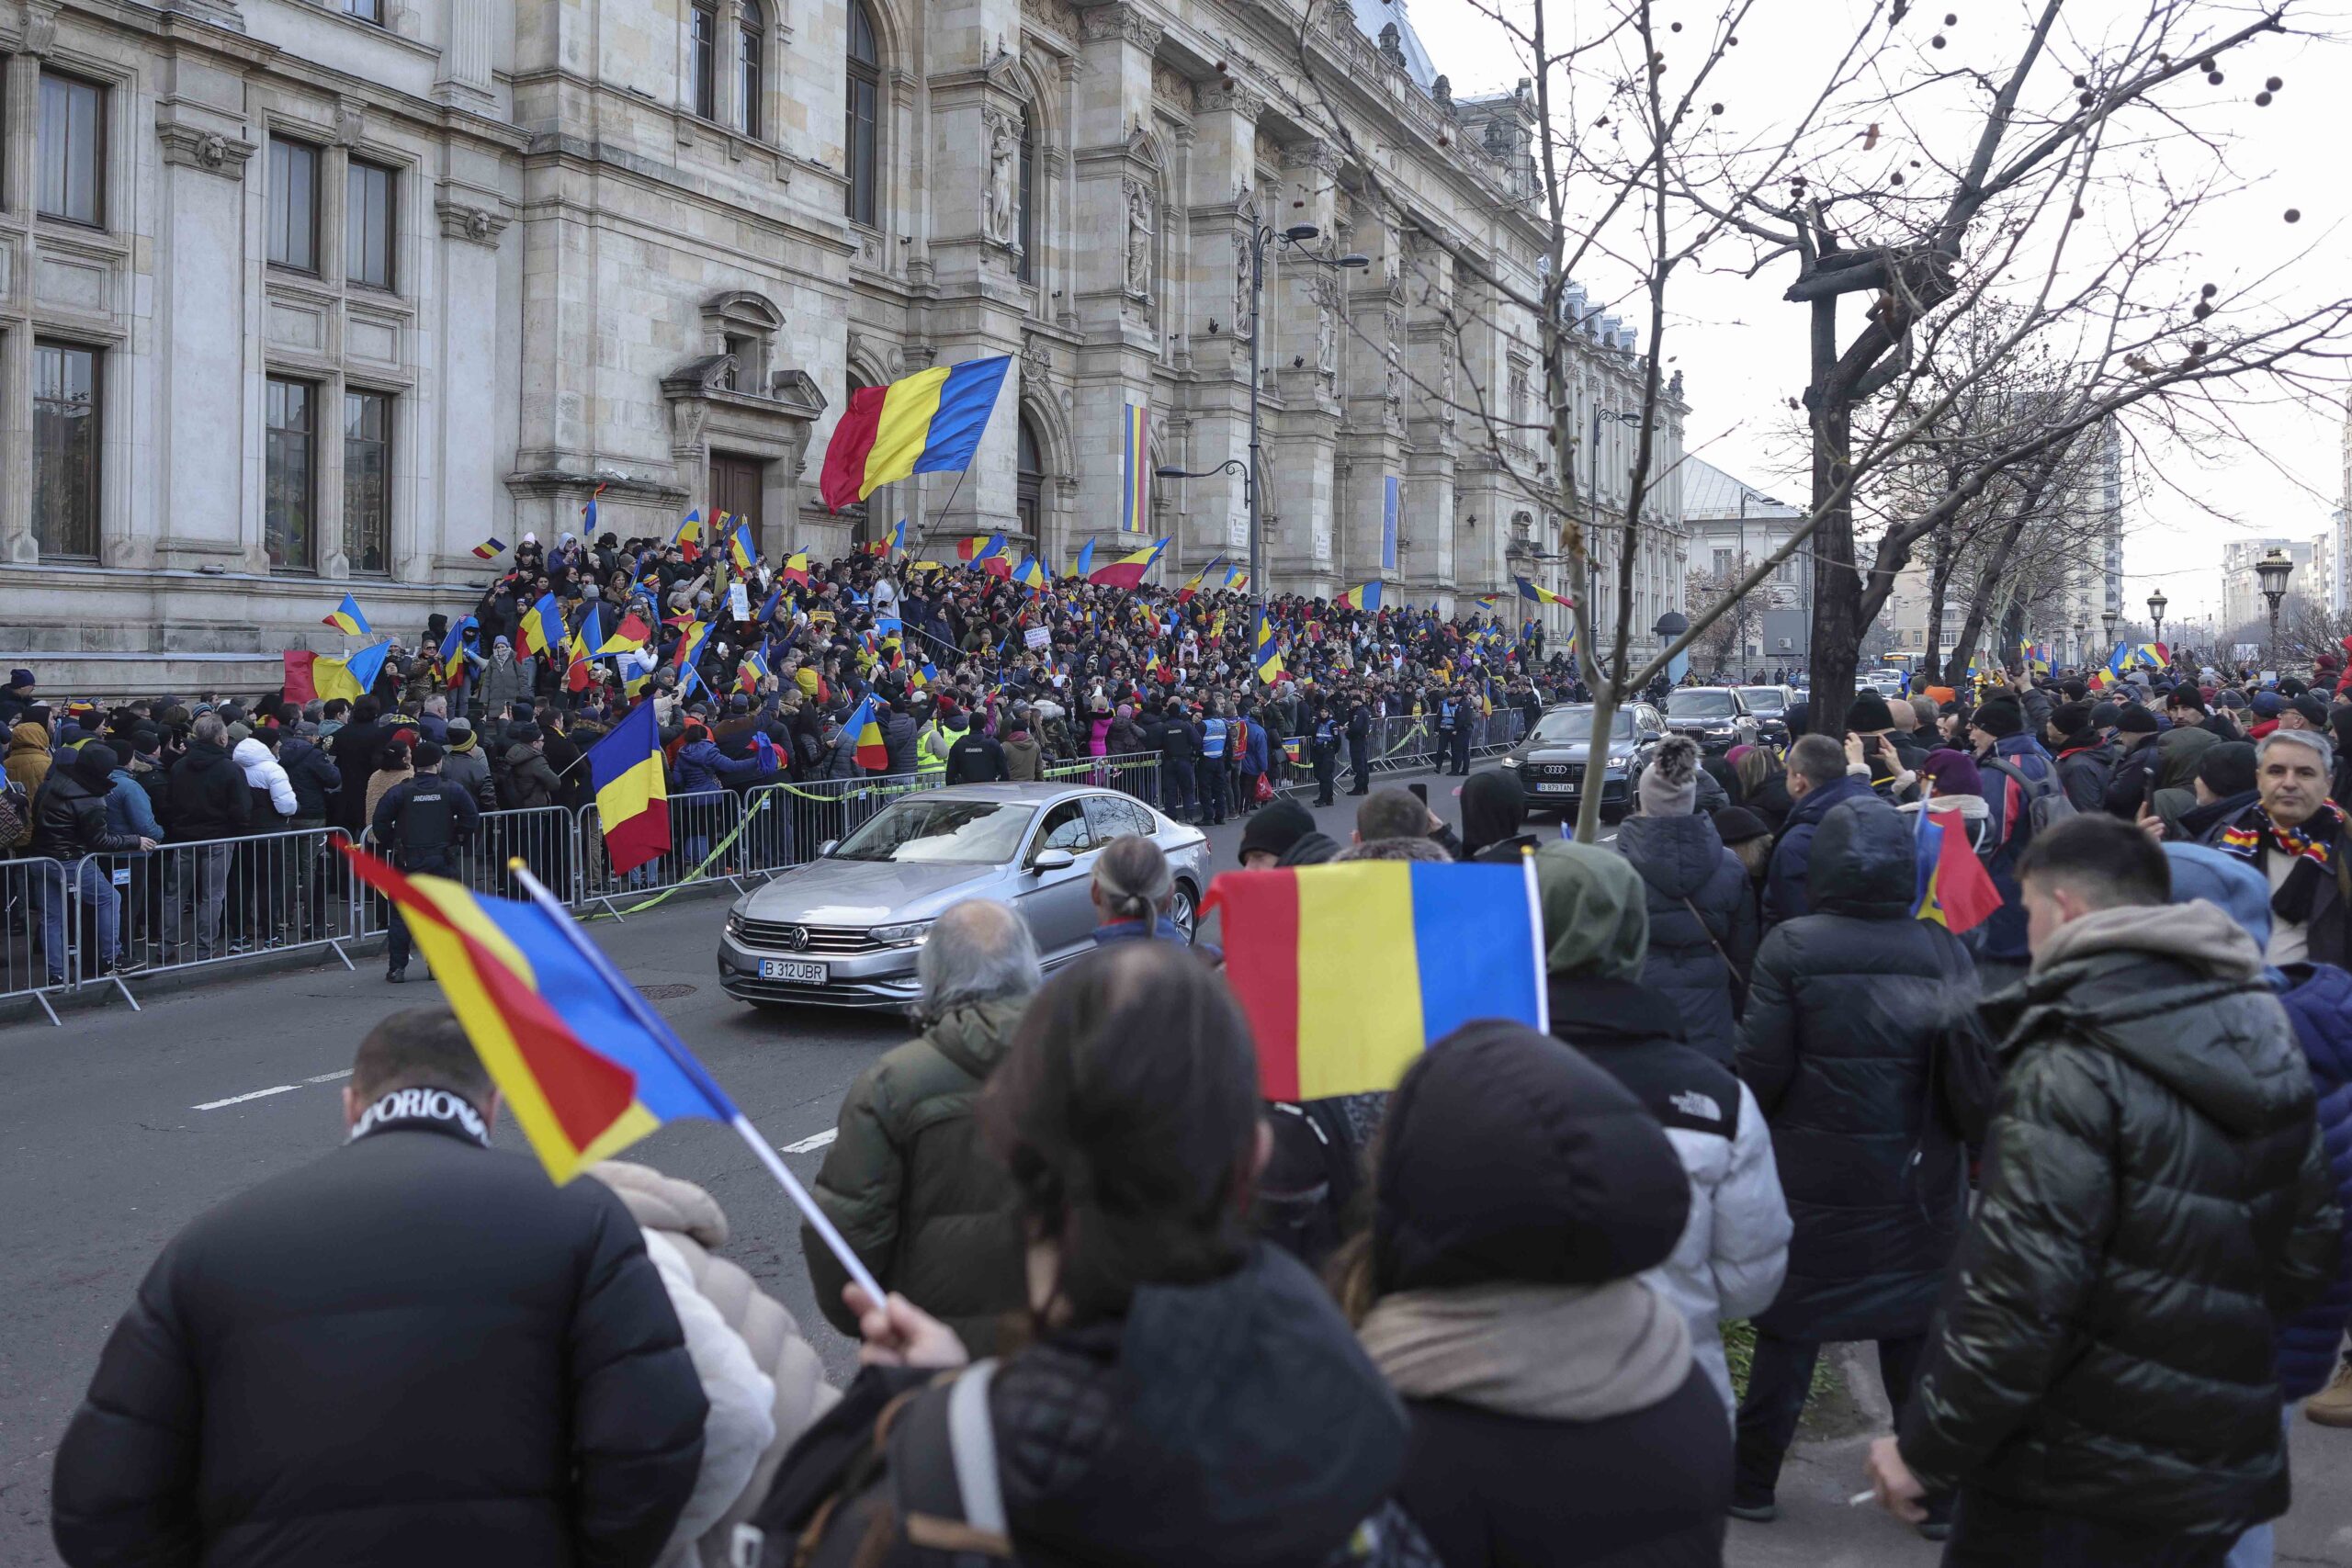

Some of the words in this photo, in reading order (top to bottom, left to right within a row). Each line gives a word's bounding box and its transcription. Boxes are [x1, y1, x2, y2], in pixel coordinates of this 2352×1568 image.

[765, 962, 774, 976] B
[777, 963, 795, 977] 312
[797, 964, 822, 979] UBR
